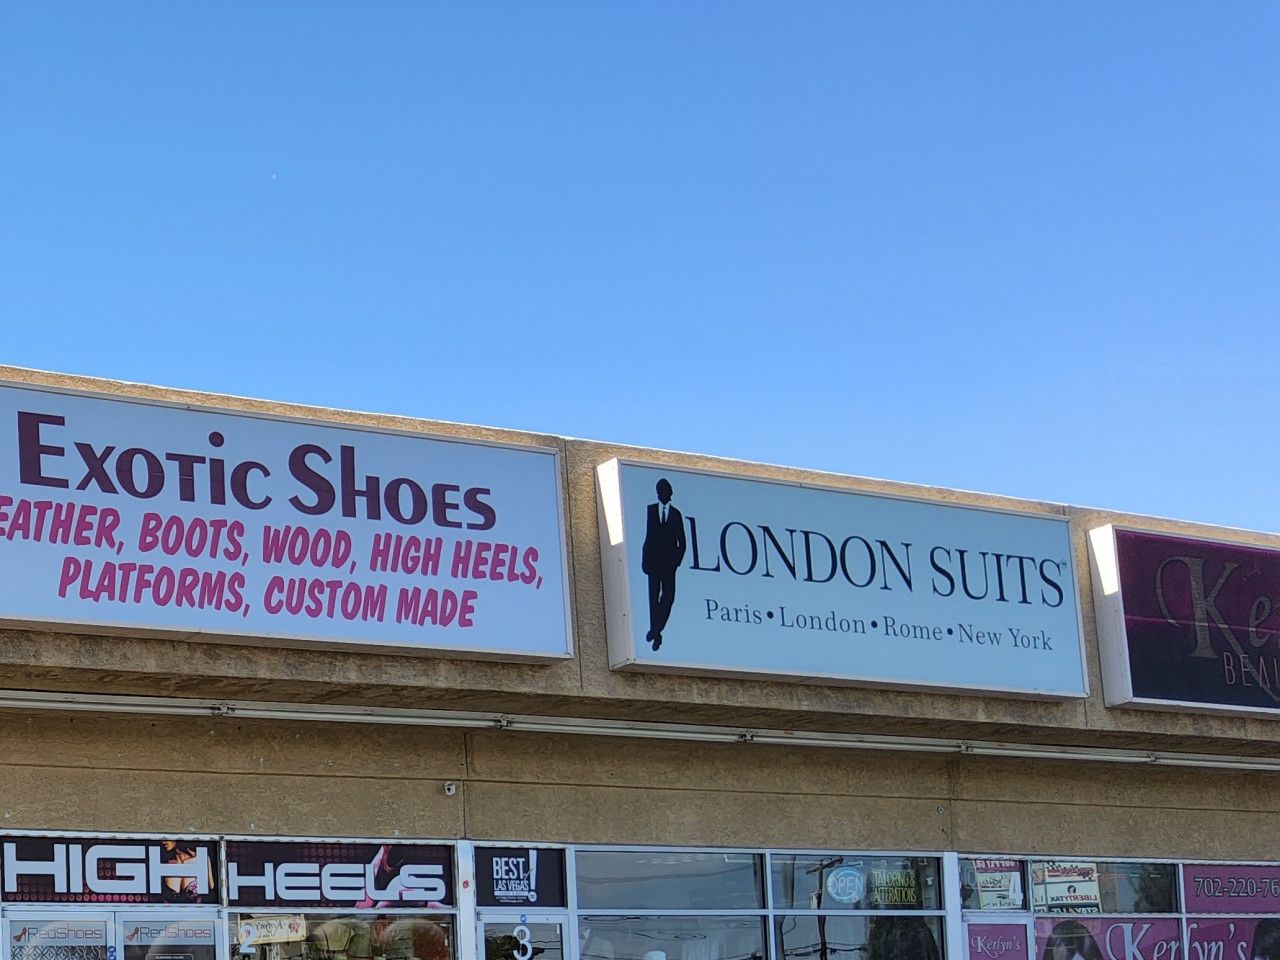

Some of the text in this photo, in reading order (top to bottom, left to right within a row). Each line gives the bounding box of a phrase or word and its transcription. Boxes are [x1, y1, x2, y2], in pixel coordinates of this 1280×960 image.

[139, 511, 248, 564] BOOTS,
[261, 524, 357, 575] WOOD,
[369, 531, 441, 576] HIGH
[450, 539, 544, 589] HEELS,
[684, 515, 1065, 608] LONDON SUITS
[58, 557, 478, 628] PLATFORMS, CUSTOM MADE
[1007, 627, 1053, 652] York
[1156, 556, 1280, 701] Ke
[3, 842, 209, 894] HIGH
[228, 861, 447, 902] HEELS
[494, 880, 529, 891] LAS VEGAS
[828, 876, 863, 893] OPEN
[240, 924, 256, 953] 2
[512, 925, 532, 960] 3
[971, 936, 1021, 959] Kerlyn's
